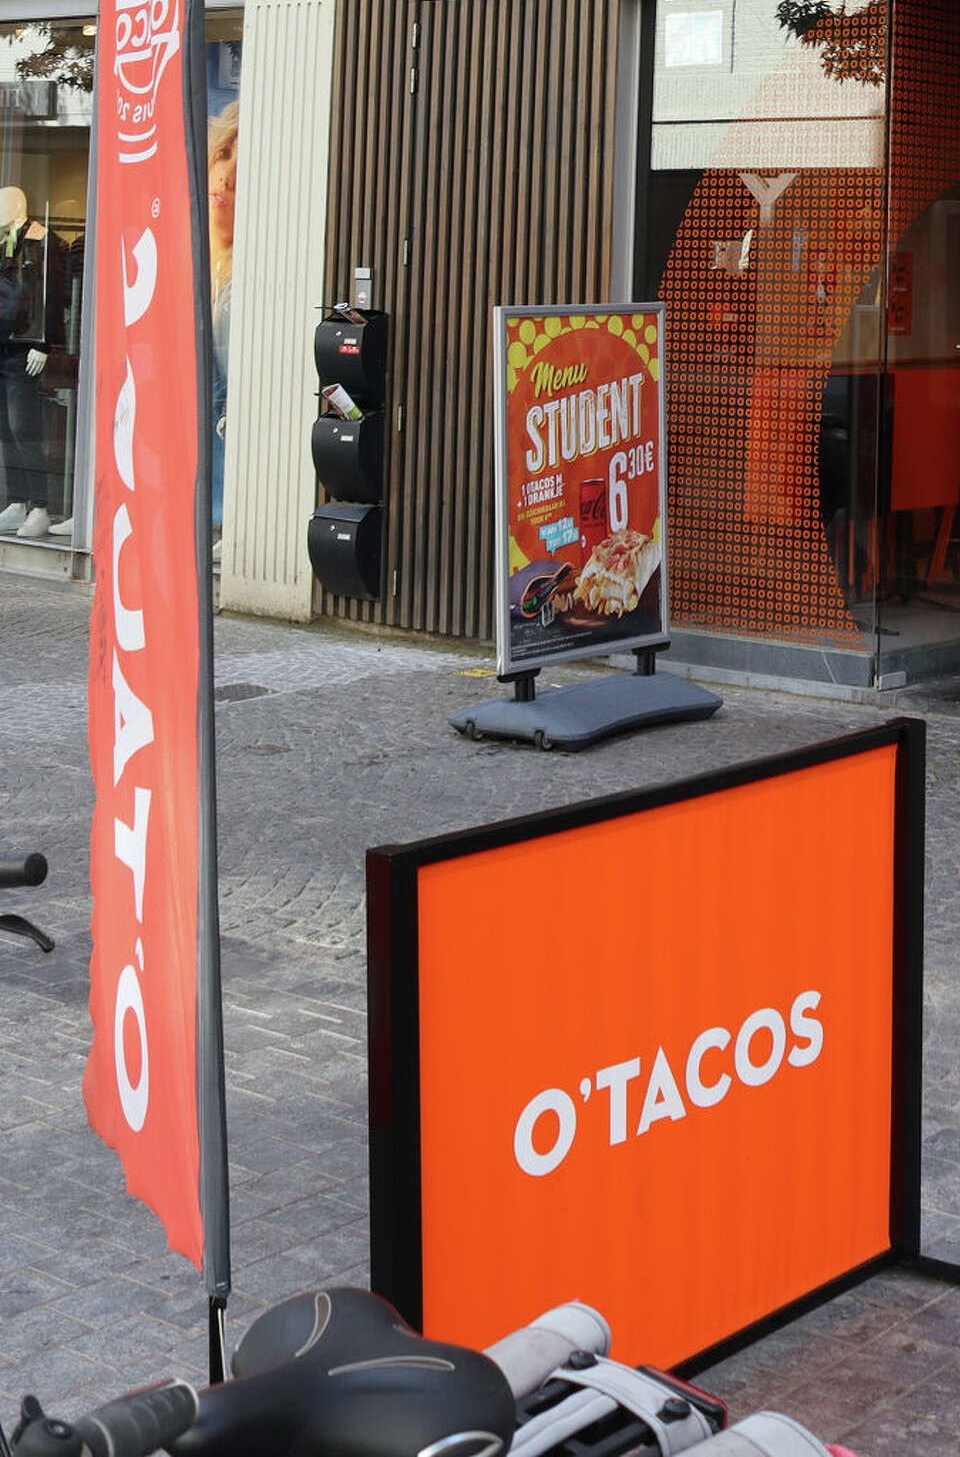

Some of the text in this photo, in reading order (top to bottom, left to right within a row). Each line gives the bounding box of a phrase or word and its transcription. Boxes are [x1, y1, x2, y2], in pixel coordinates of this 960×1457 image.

[526, 372, 646, 476] STUDENT
[529, 360, 588, 399] Menu
[513, 990, 824, 1177] O'TACOS
